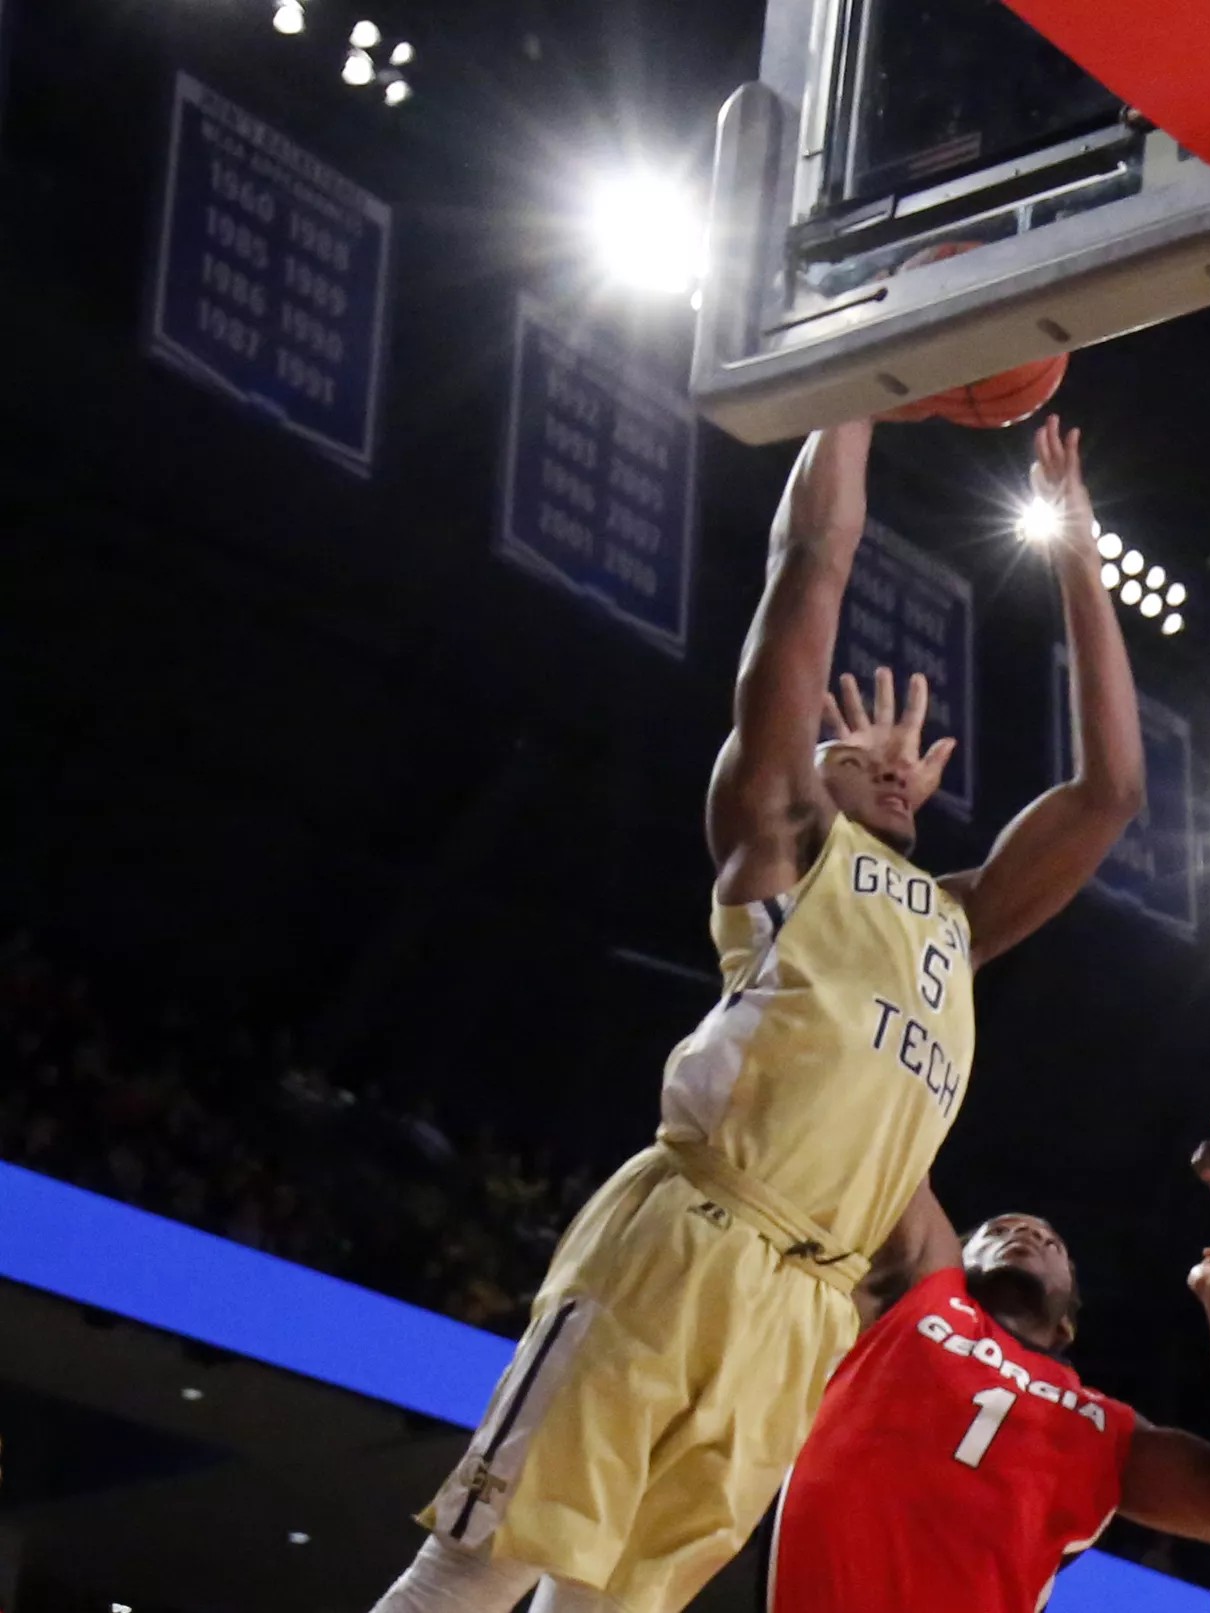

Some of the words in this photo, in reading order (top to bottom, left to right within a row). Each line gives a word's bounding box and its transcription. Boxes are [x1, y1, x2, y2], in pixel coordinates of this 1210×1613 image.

[920, 943, 950, 1010] 5
[873, 997, 960, 1119] TECH
[953, 1387, 1018, 1469] 1
